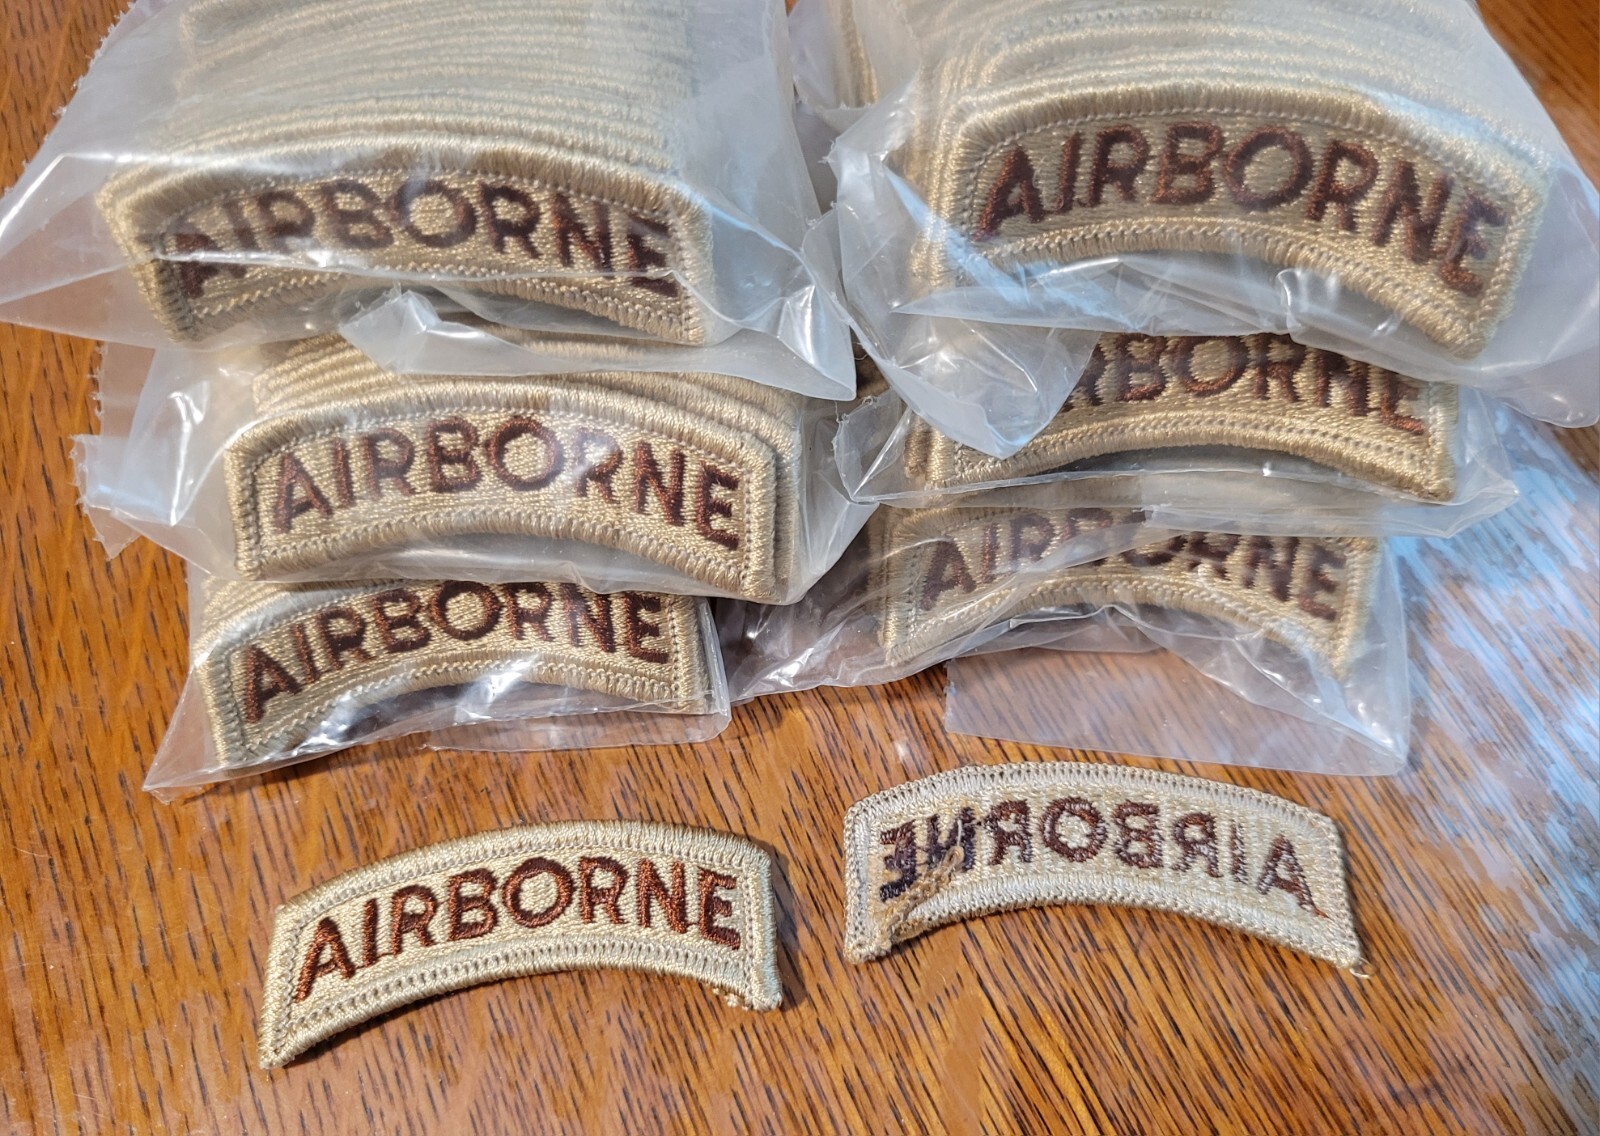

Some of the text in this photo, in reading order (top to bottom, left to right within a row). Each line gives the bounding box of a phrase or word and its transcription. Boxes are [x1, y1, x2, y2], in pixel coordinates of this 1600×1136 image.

[174, 178, 680, 298] AIRBORNE
[974, 122, 1507, 297] AIRBORNE
[273, 415, 740, 551] AIRBORNE
[246, 580, 669, 723] AIRBORNE
[297, 856, 740, 1003] AIRBORNE
